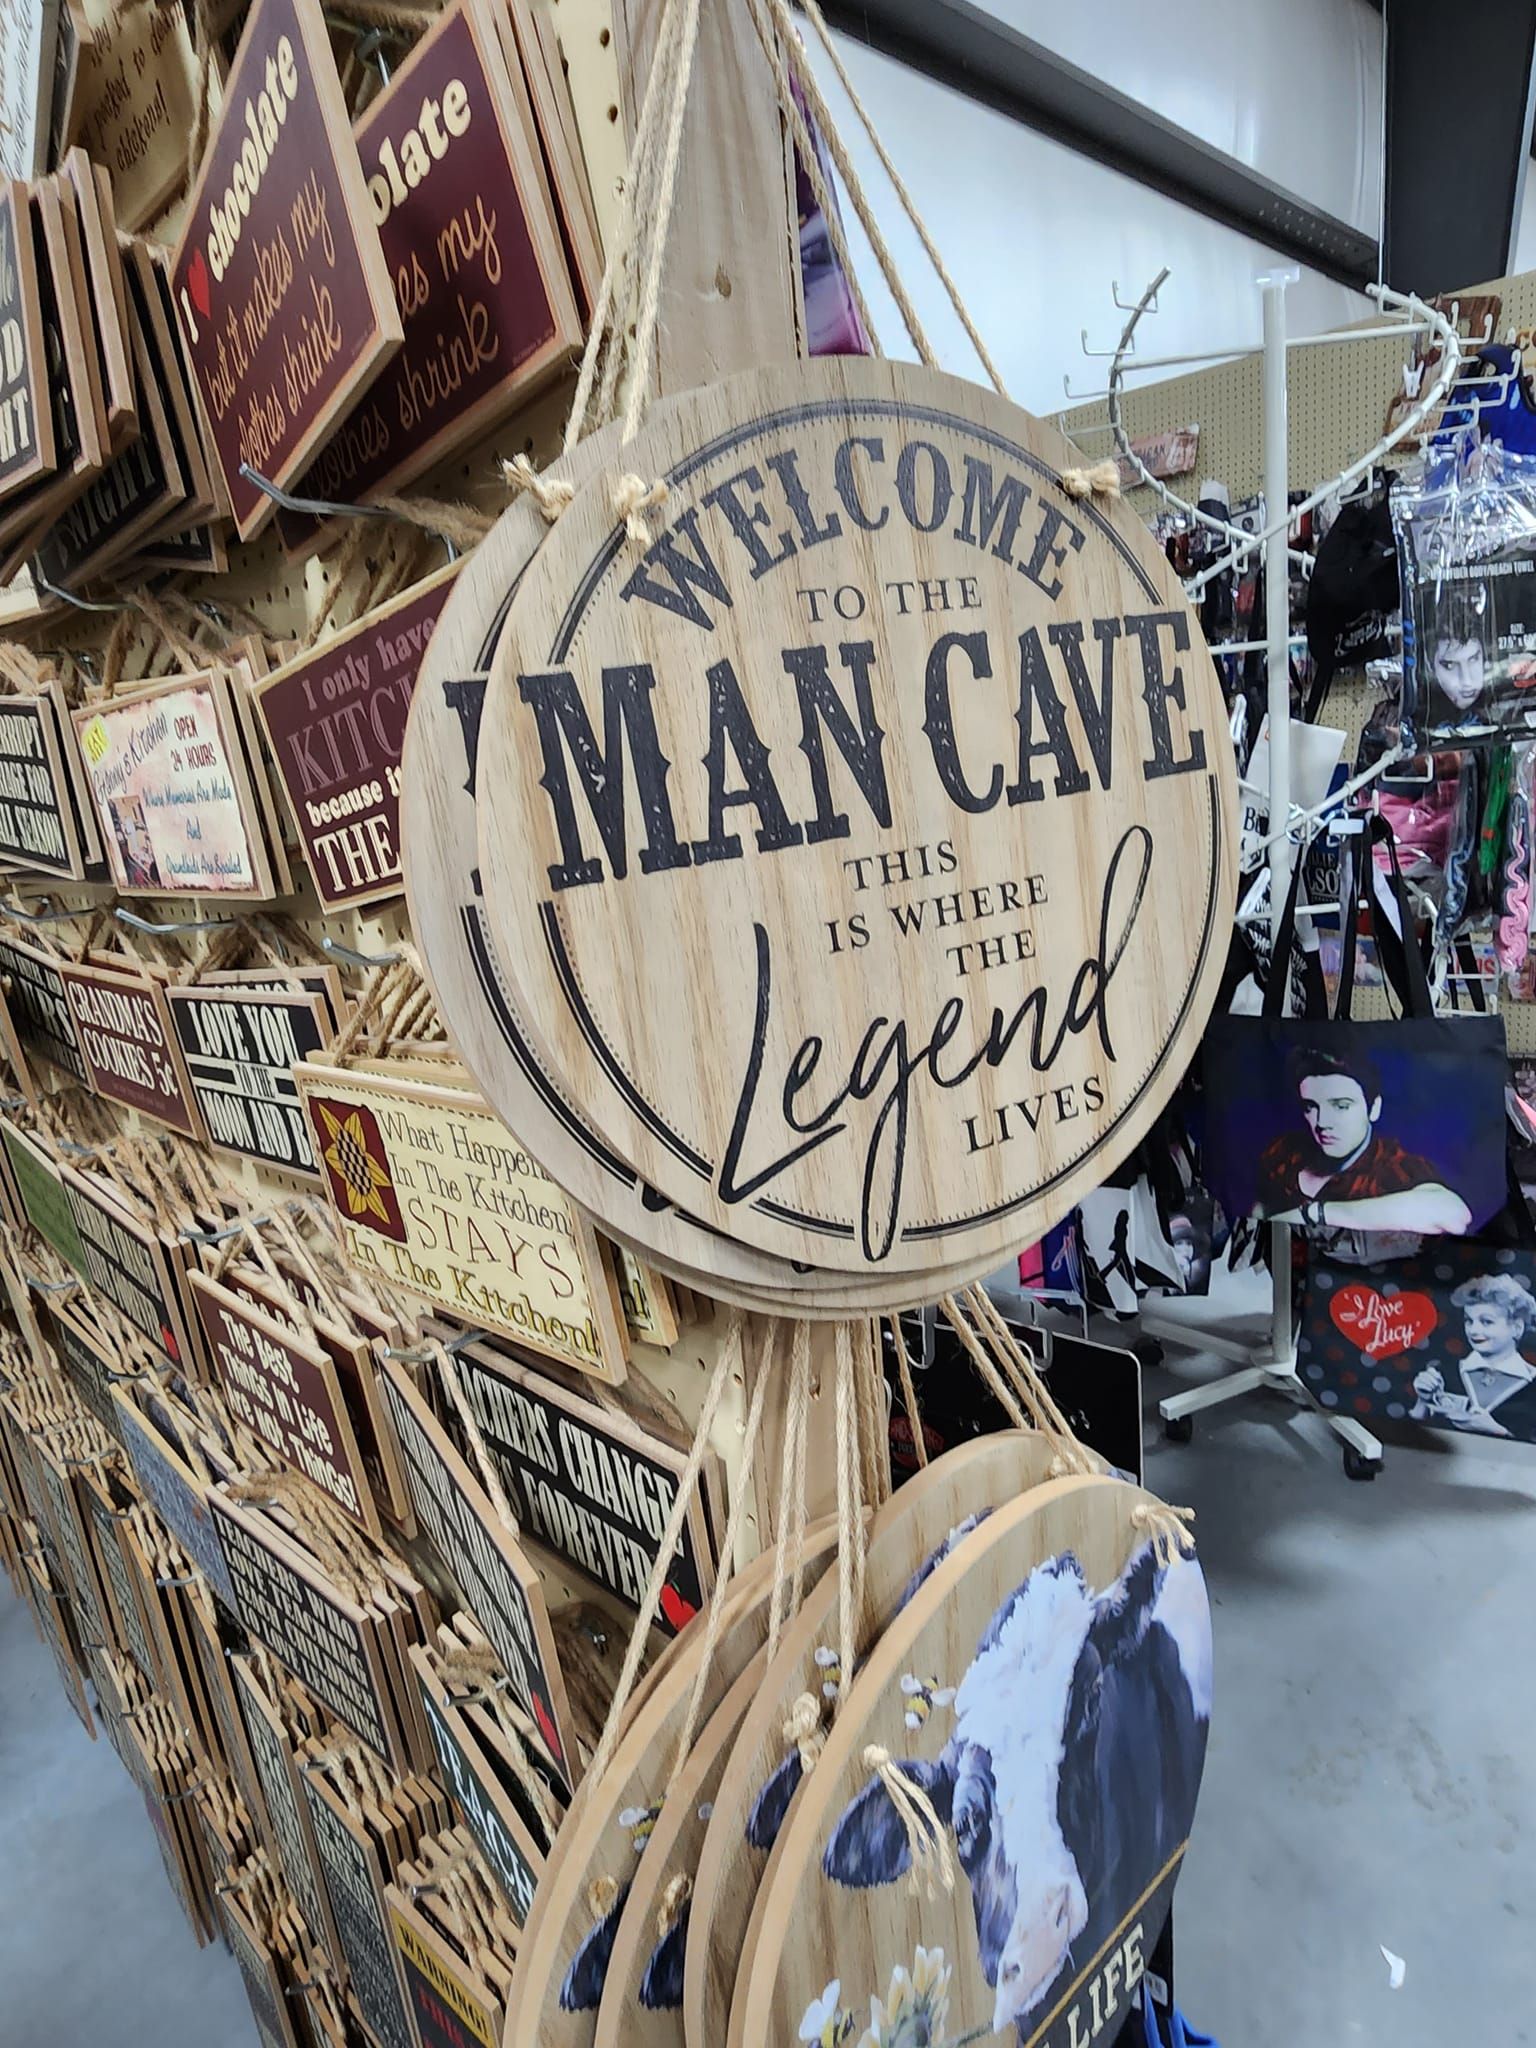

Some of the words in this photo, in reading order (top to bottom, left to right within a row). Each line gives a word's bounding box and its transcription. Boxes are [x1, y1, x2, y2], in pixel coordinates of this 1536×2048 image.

[207, 35, 298, 282] chocolate
[367, 79, 472, 227] olate
[436, 194, 501, 285] my
[205, 333, 236, 421] but
[226, 305, 248, 380] it
[243, 225, 293, 358] makes
[290, 167, 335, 268] my
[238, 383, 286, 472] clothes
[282, 272, 342, 416] shrink
[399, 295, 499, 430] shrink
[619, 437, 1087, 631] WELCOME
[797, 585, 866, 622] TO
[885, 577, 983, 616] THE
[302, 678, 317, 711] I
[322, 653, 372, 701] only
[375, 616, 436, 671] have
[170, 749, 183, 772] 24
[187, 742, 217, 770] HOURS
[173, 714, 198, 740] OPEN
[517, 640, 893, 892] MAN
[921, 611, 1208, 813] CAVE
[24, 763, 55, 806] FOR
[305, 778, 384, 827] because
[14, 805, 66, 860] SEASON
[313, 813, 402, 892] THE
[843, 839, 959, 891] THIS
[824, 913, 870, 954] IS
[891, 874, 1049, 938] WHERE
[946, 928, 1037, 977] THE
[68, 981, 163, 1047] GRANDMA'S
[187, 1000, 250, 1062] LOVE
[242, 1004, 300, 1067] YOU
[718, 824, 1153, 1263] Legend
[83, 1028, 155, 1091] COOKIES
[235, 1064, 253, 1096] TO
[250, 1066, 276, 1098] THE
[200, 1089, 256, 1150] MOON
[249, 1100, 293, 1160] AND
[375, 1110, 443, 1155] What
[447, 1122, 555, 1183] Happen
[962, 1074, 1104, 1155] LIVES
[388, 1153, 414, 1187] In
[417, 1158, 462, 1202] The
[471, 1175, 572, 1237] Kitchen
[347, 1227, 379, 1265] In
[383, 1241, 442, 1290] The
[448, 1265, 599, 1357] Kitchen!
[408, 1198, 575, 1299] STAYS
[219, 1309, 255, 1358] The
[252, 1329, 300, 1394] Best
[1358, 1293, 1404, 1329] Love
[217, 1342, 274, 1410] Things
[272, 1382, 295, 1425] In
[292, 1396, 333, 1456] Life
[253, 1404, 290, 1458] Not
[288, 1431, 361, 1517] Things!
[443, 1354, 558, 1476] ACHERS
[558, 1417, 684, 1558] CHANGE
[213, 1507, 304, 1606] TEACHERS
[303, 1584, 360, 1655] WHO
[221, 1536, 268, 1597] LOVE
[267, 1577, 370, 1690] TEACHING
[229, 1566, 283, 1635] TEACH
[282, 1612, 378, 1725] CHILDREN
[399, 1924, 489, 2040] WARNING!
[1067, 1923, 1145, 2048] LIFE
